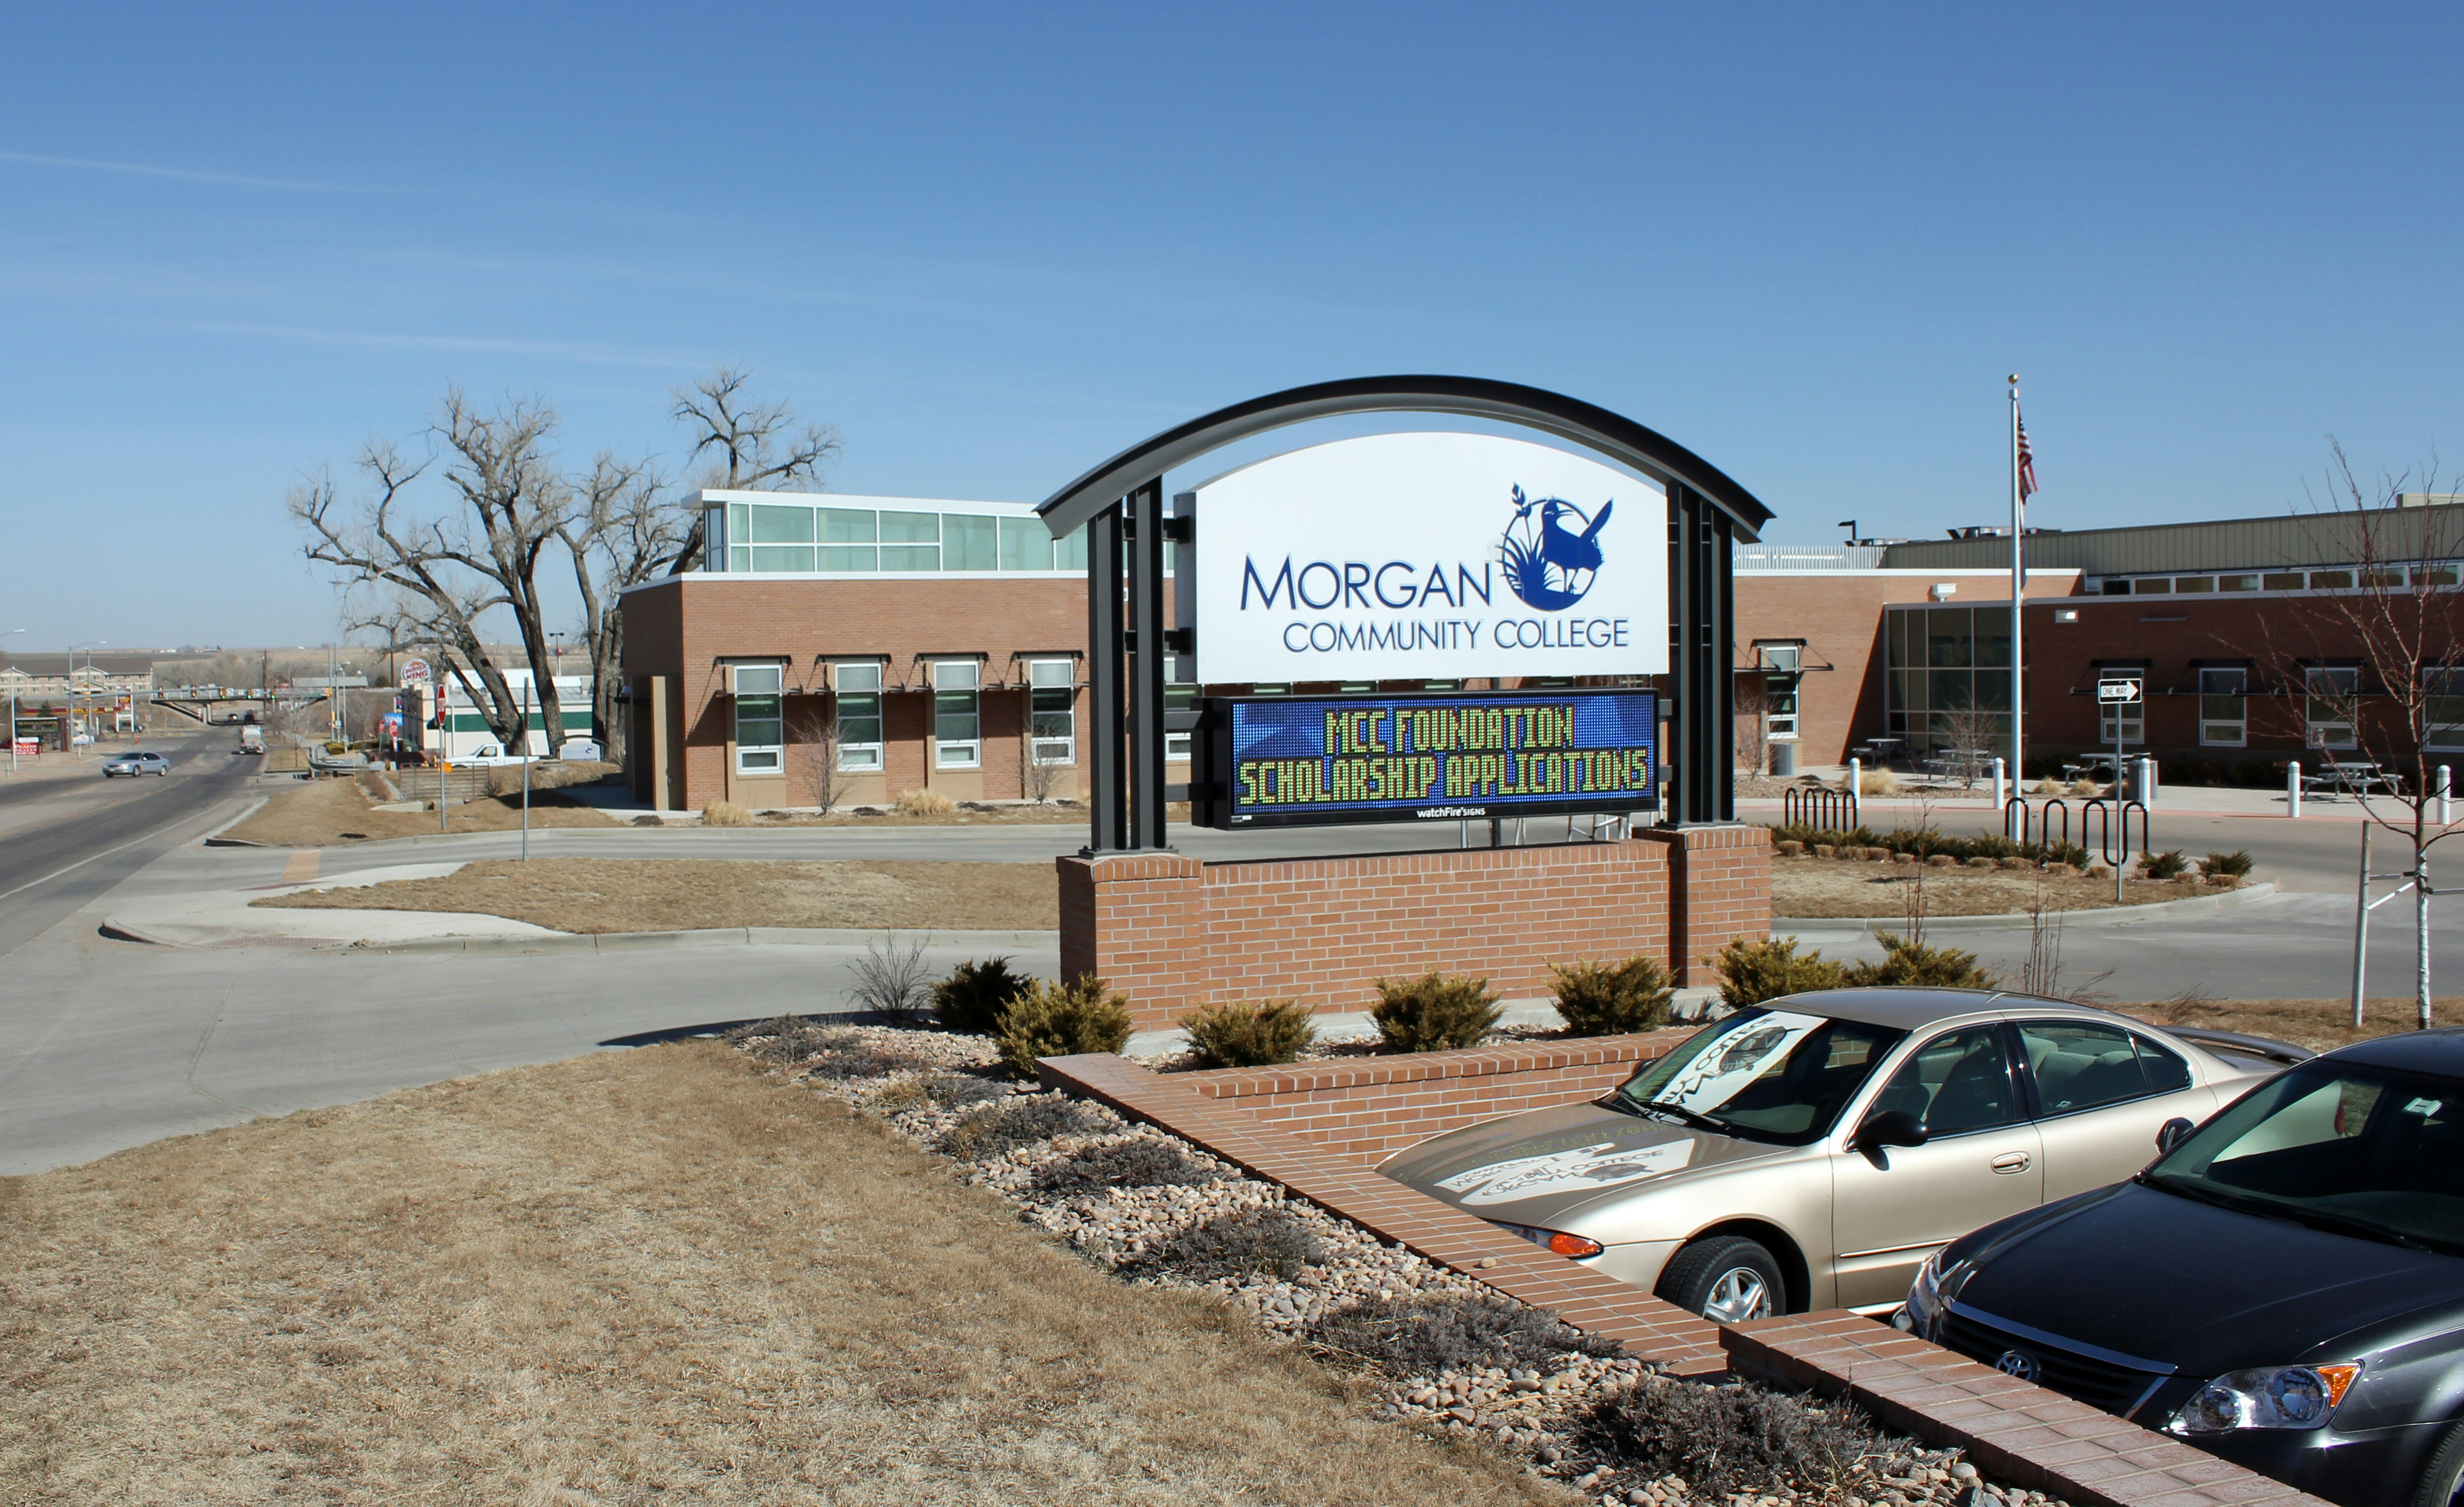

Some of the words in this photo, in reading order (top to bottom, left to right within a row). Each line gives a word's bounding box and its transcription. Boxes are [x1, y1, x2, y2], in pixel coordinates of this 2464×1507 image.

[1240, 553, 1493, 611] MORGAN
[1283, 619, 1483, 652] COMMUNITY
[1494, 617, 1629, 649] COLLEGE
[405, 664, 427, 675] BURGER
[406, 670, 428, 680] KING
[2103, 687, 2114, 696] ONE
[1325, 710, 1388, 755] MCC
[1396, 707, 1574, 752] FOUNDATION
[1239, 756, 1436, 805] SCHOLARSHIP
[1446, 749, 1647, 798] APPLICATIONS
[1463, 808, 1486, 816] SIGNS
